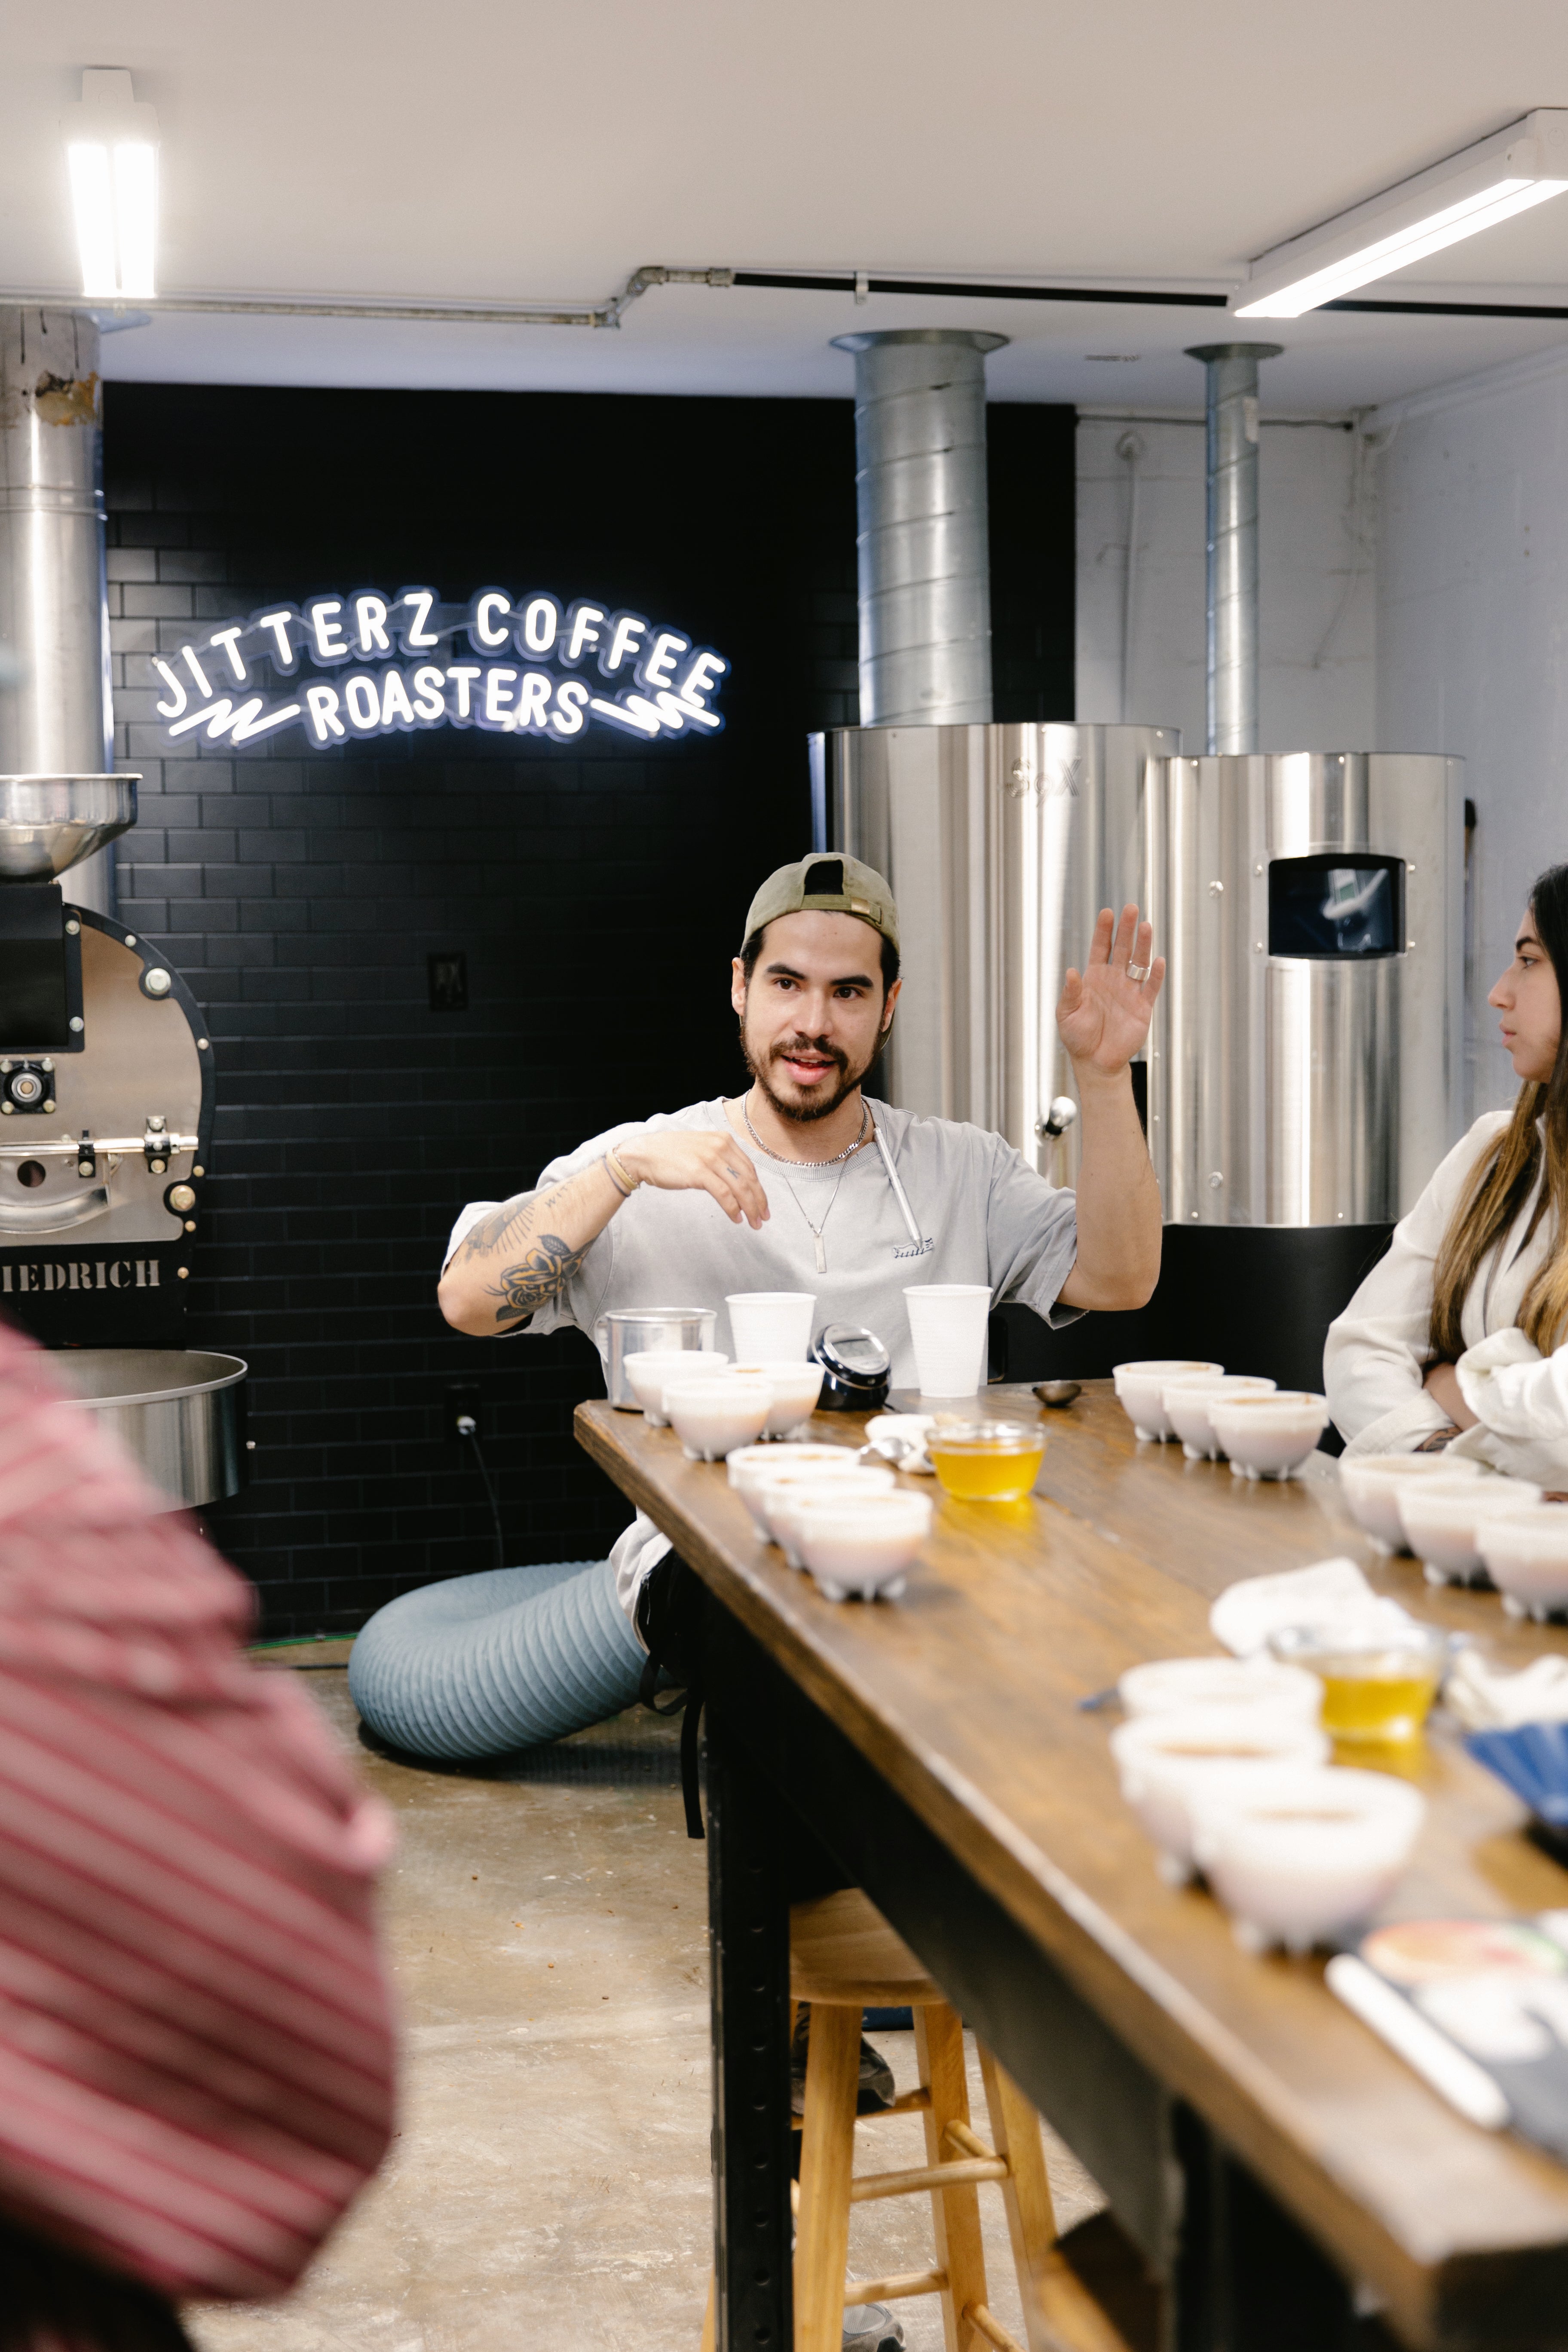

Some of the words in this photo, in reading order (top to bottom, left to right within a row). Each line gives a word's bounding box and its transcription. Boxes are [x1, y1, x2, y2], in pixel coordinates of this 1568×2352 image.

[155, 592, 439, 719] JITTERZ
[476, 593, 726, 707] COFFEE
[306, 666, 589, 741] ROASTERS
